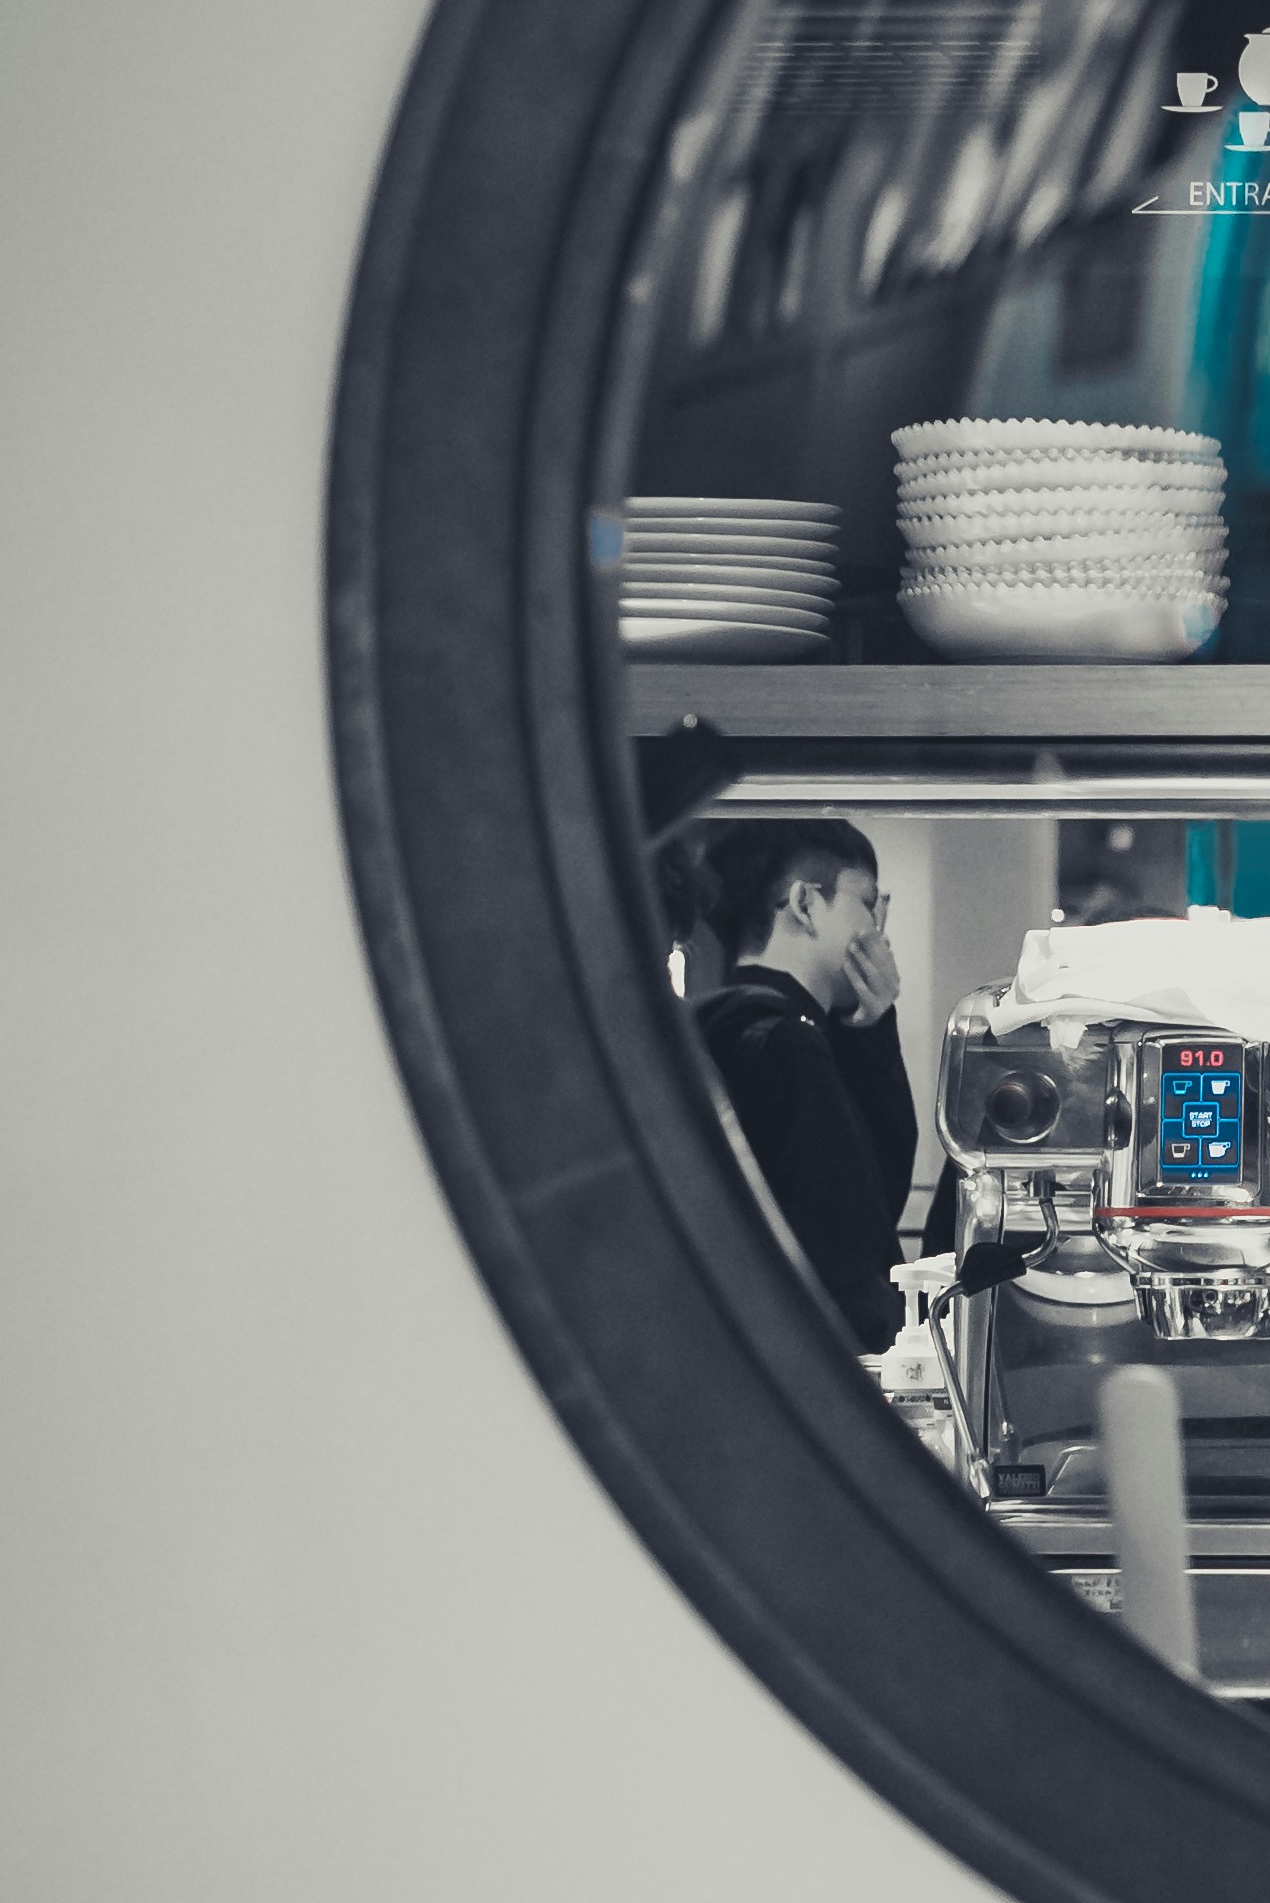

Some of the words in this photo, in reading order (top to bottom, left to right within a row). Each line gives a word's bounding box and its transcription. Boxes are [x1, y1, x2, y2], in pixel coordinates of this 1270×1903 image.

[1180, 1050, 1224, 1066] 91.0
[1189, 1111, 1212, 1120] START
[1191, 1119, 1211, 1128] STOP
